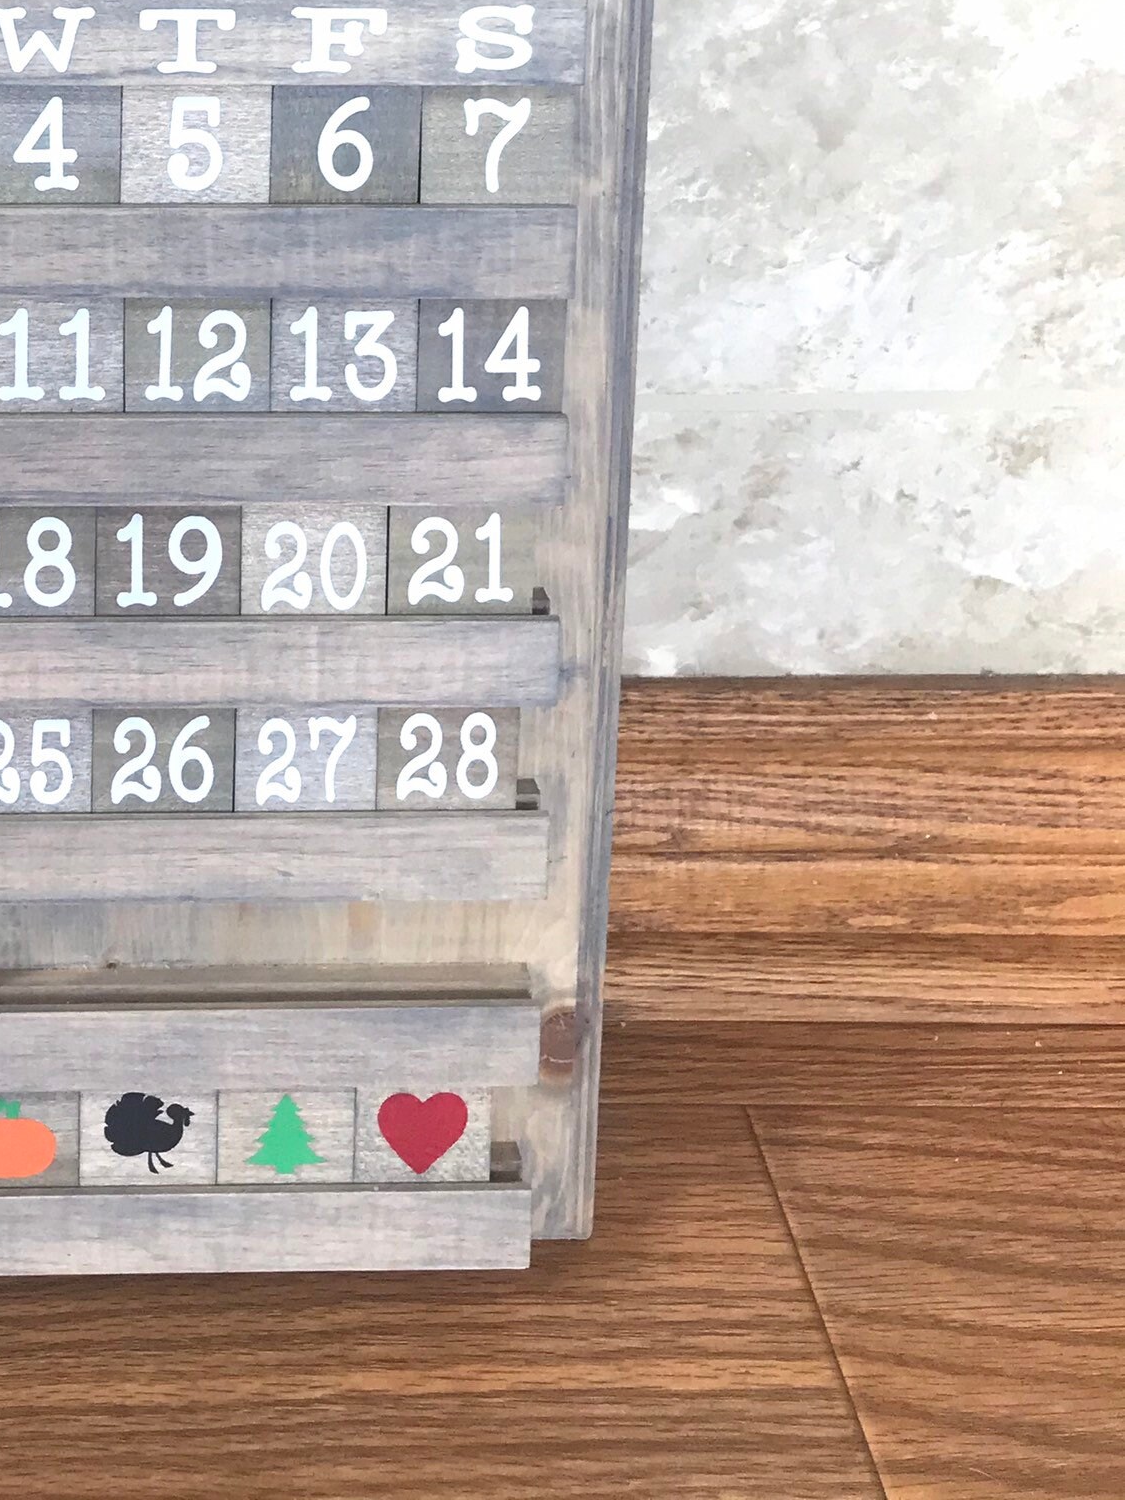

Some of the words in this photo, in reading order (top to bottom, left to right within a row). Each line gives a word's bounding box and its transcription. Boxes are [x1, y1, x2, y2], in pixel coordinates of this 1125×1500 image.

[138, 7, 237, 74] T
[290, 7, 388, 75] F
[454, 3, 536, 74] S
[12, 96, 80, 191] 4
[166, 95, 224, 191] 5
[316, 95, 374, 192] 6
[463, 96, 532, 193] 7
[144, 305, 252, 402] 12
[289, 305, 398, 402] 13
[437, 305, 542, 402] 14
[115, 512, 223, 609] 19
[260, 520, 368, 612] 20
[407, 512, 514, 606] 21
[110, 715, 215, 805] 26
[255, 714, 357, 806] 27
[396, 711, 499, 800] 28
